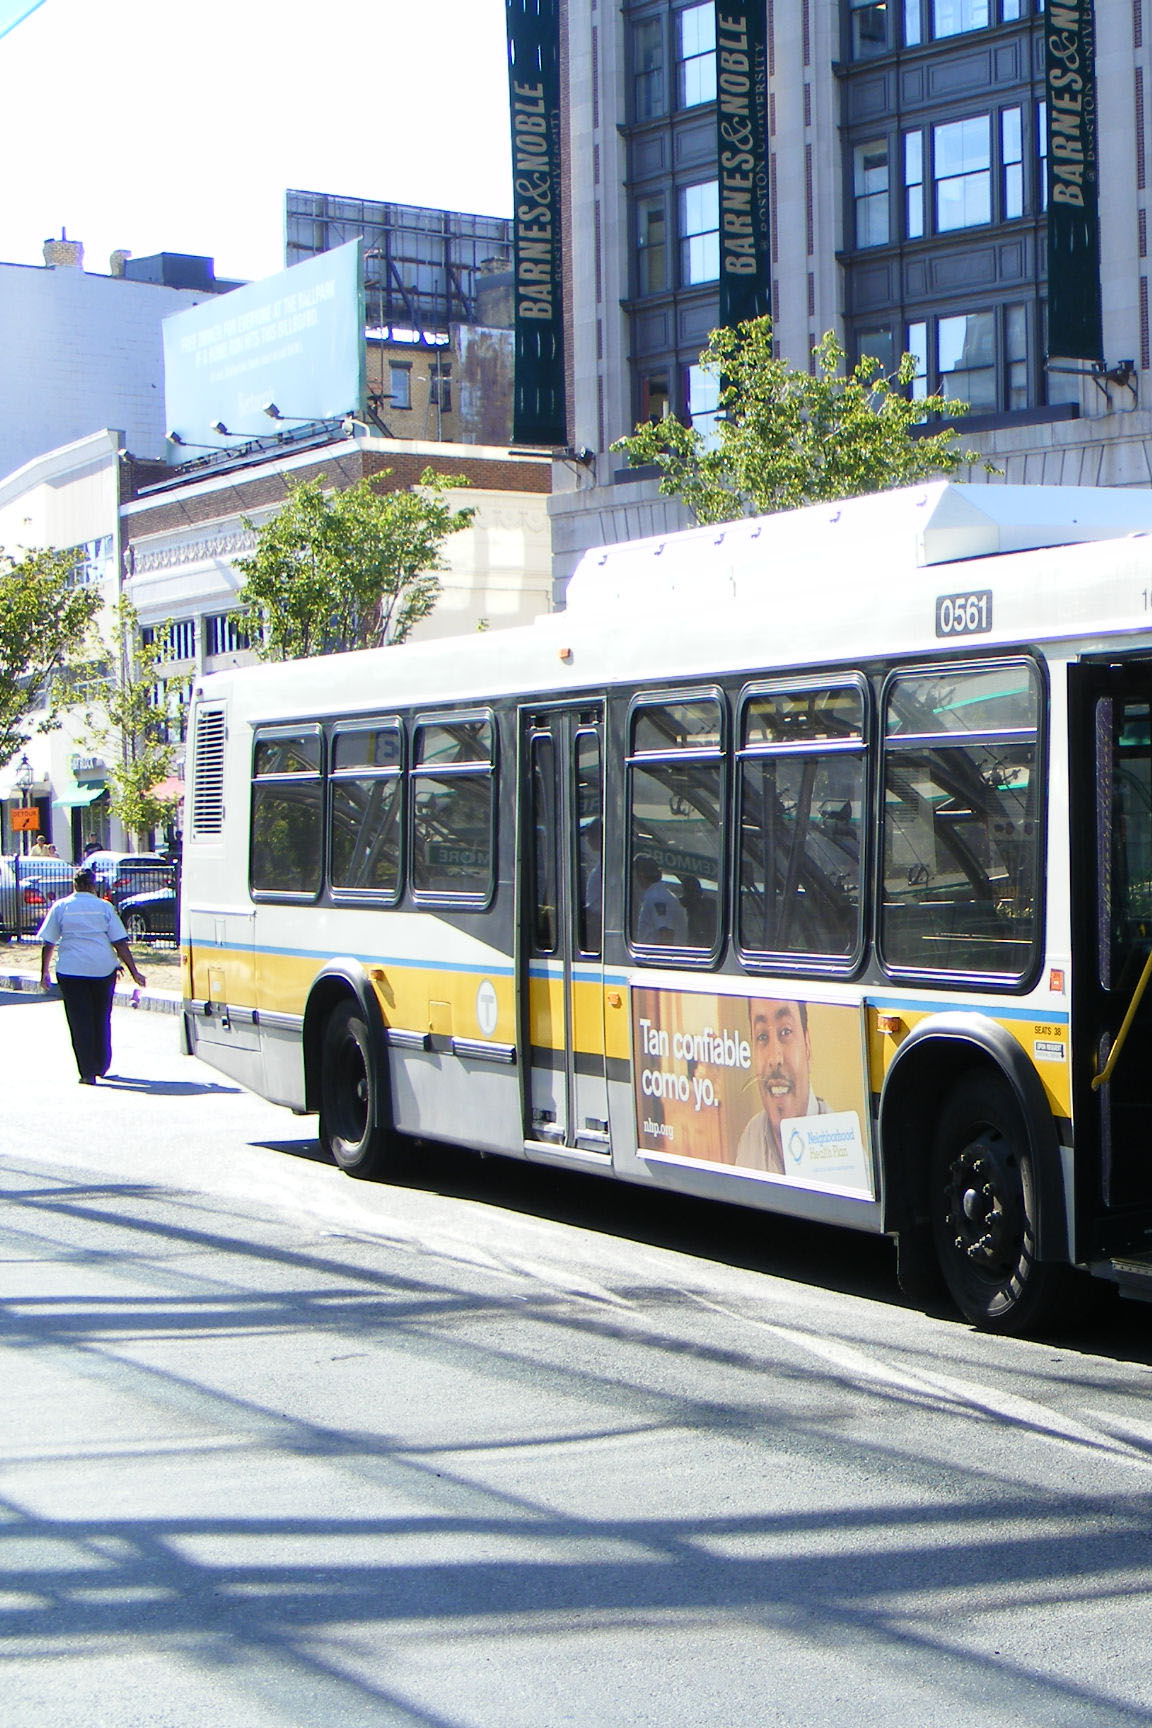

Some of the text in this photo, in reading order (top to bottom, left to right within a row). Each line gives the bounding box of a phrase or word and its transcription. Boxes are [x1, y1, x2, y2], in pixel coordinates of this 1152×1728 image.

[754, 42, 766, 153] UIVERSITY
[940, 595, 988, 633] 0561
[13, 809, 37, 818] DETOUR
[639, 1018, 752, 1069] Tan confiable
[1034, 1025, 1052, 1036] SEATS
[642, 1069, 719, 1112] como yo.
[643, 1117, 674, 1141] nhp.org
